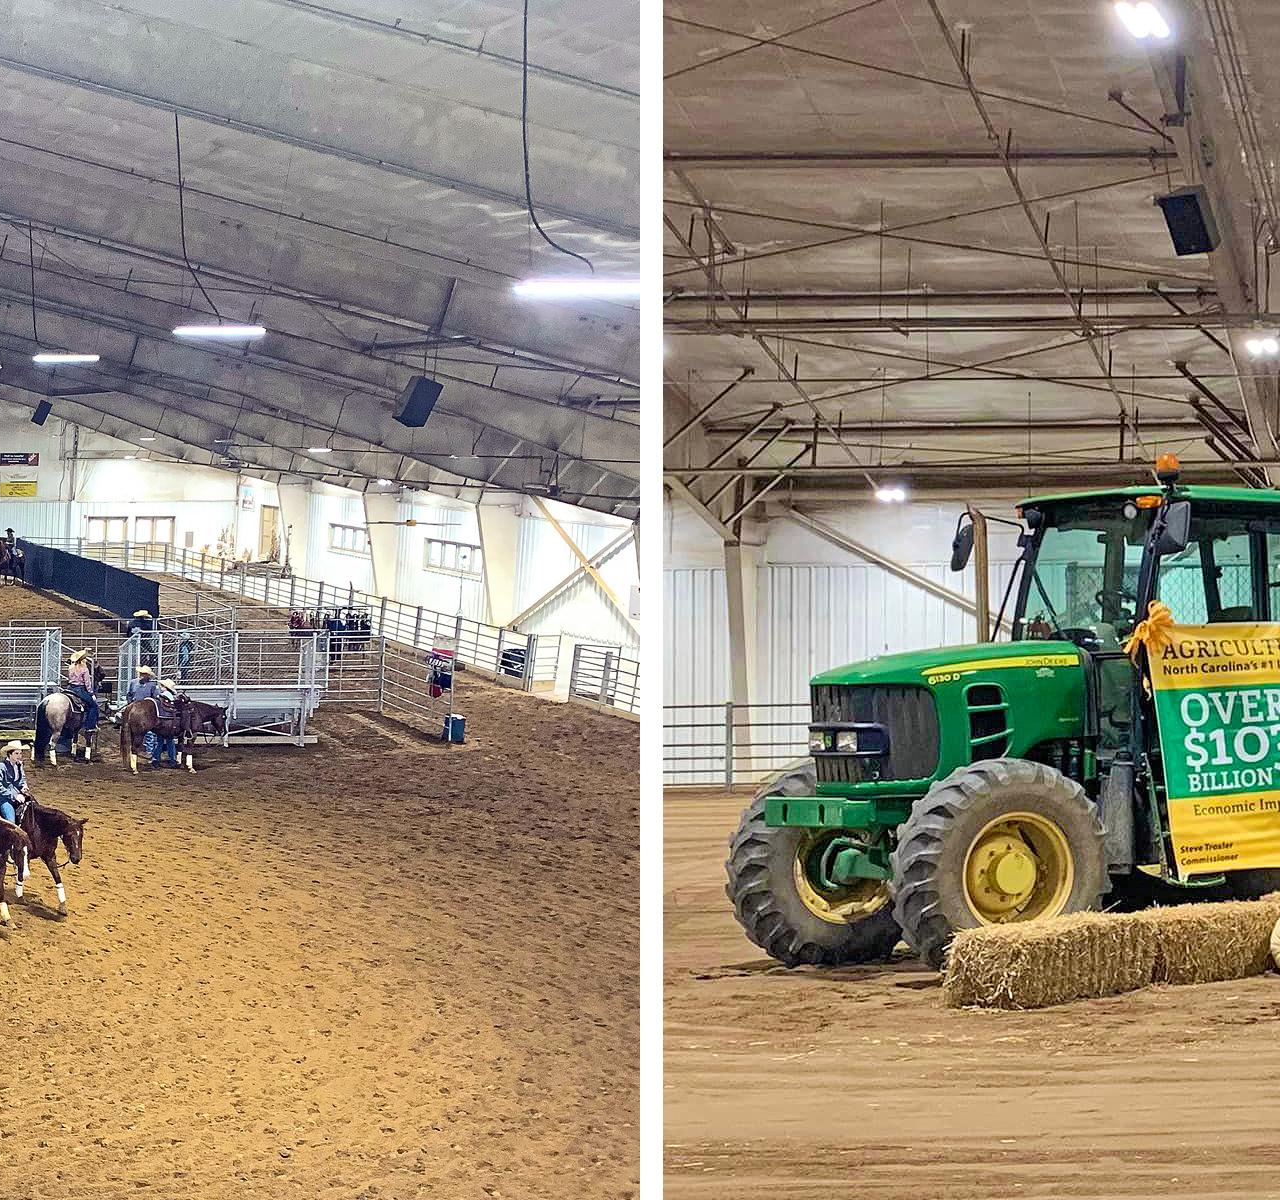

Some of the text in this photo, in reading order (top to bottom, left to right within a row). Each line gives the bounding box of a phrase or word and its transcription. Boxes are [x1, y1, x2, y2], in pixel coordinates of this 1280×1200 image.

[1163, 663, 1198, 676] North
[1202, 661, 1258, 675] Carolina's
[1261, 660, 1274, 670] #1
[1188, 767, 1274, 793] BILLION
[1193, 802, 1256, 817] Economic
[1180, 844, 1204, 854] Steve
[1181, 853, 1239, 866] Commissioner
